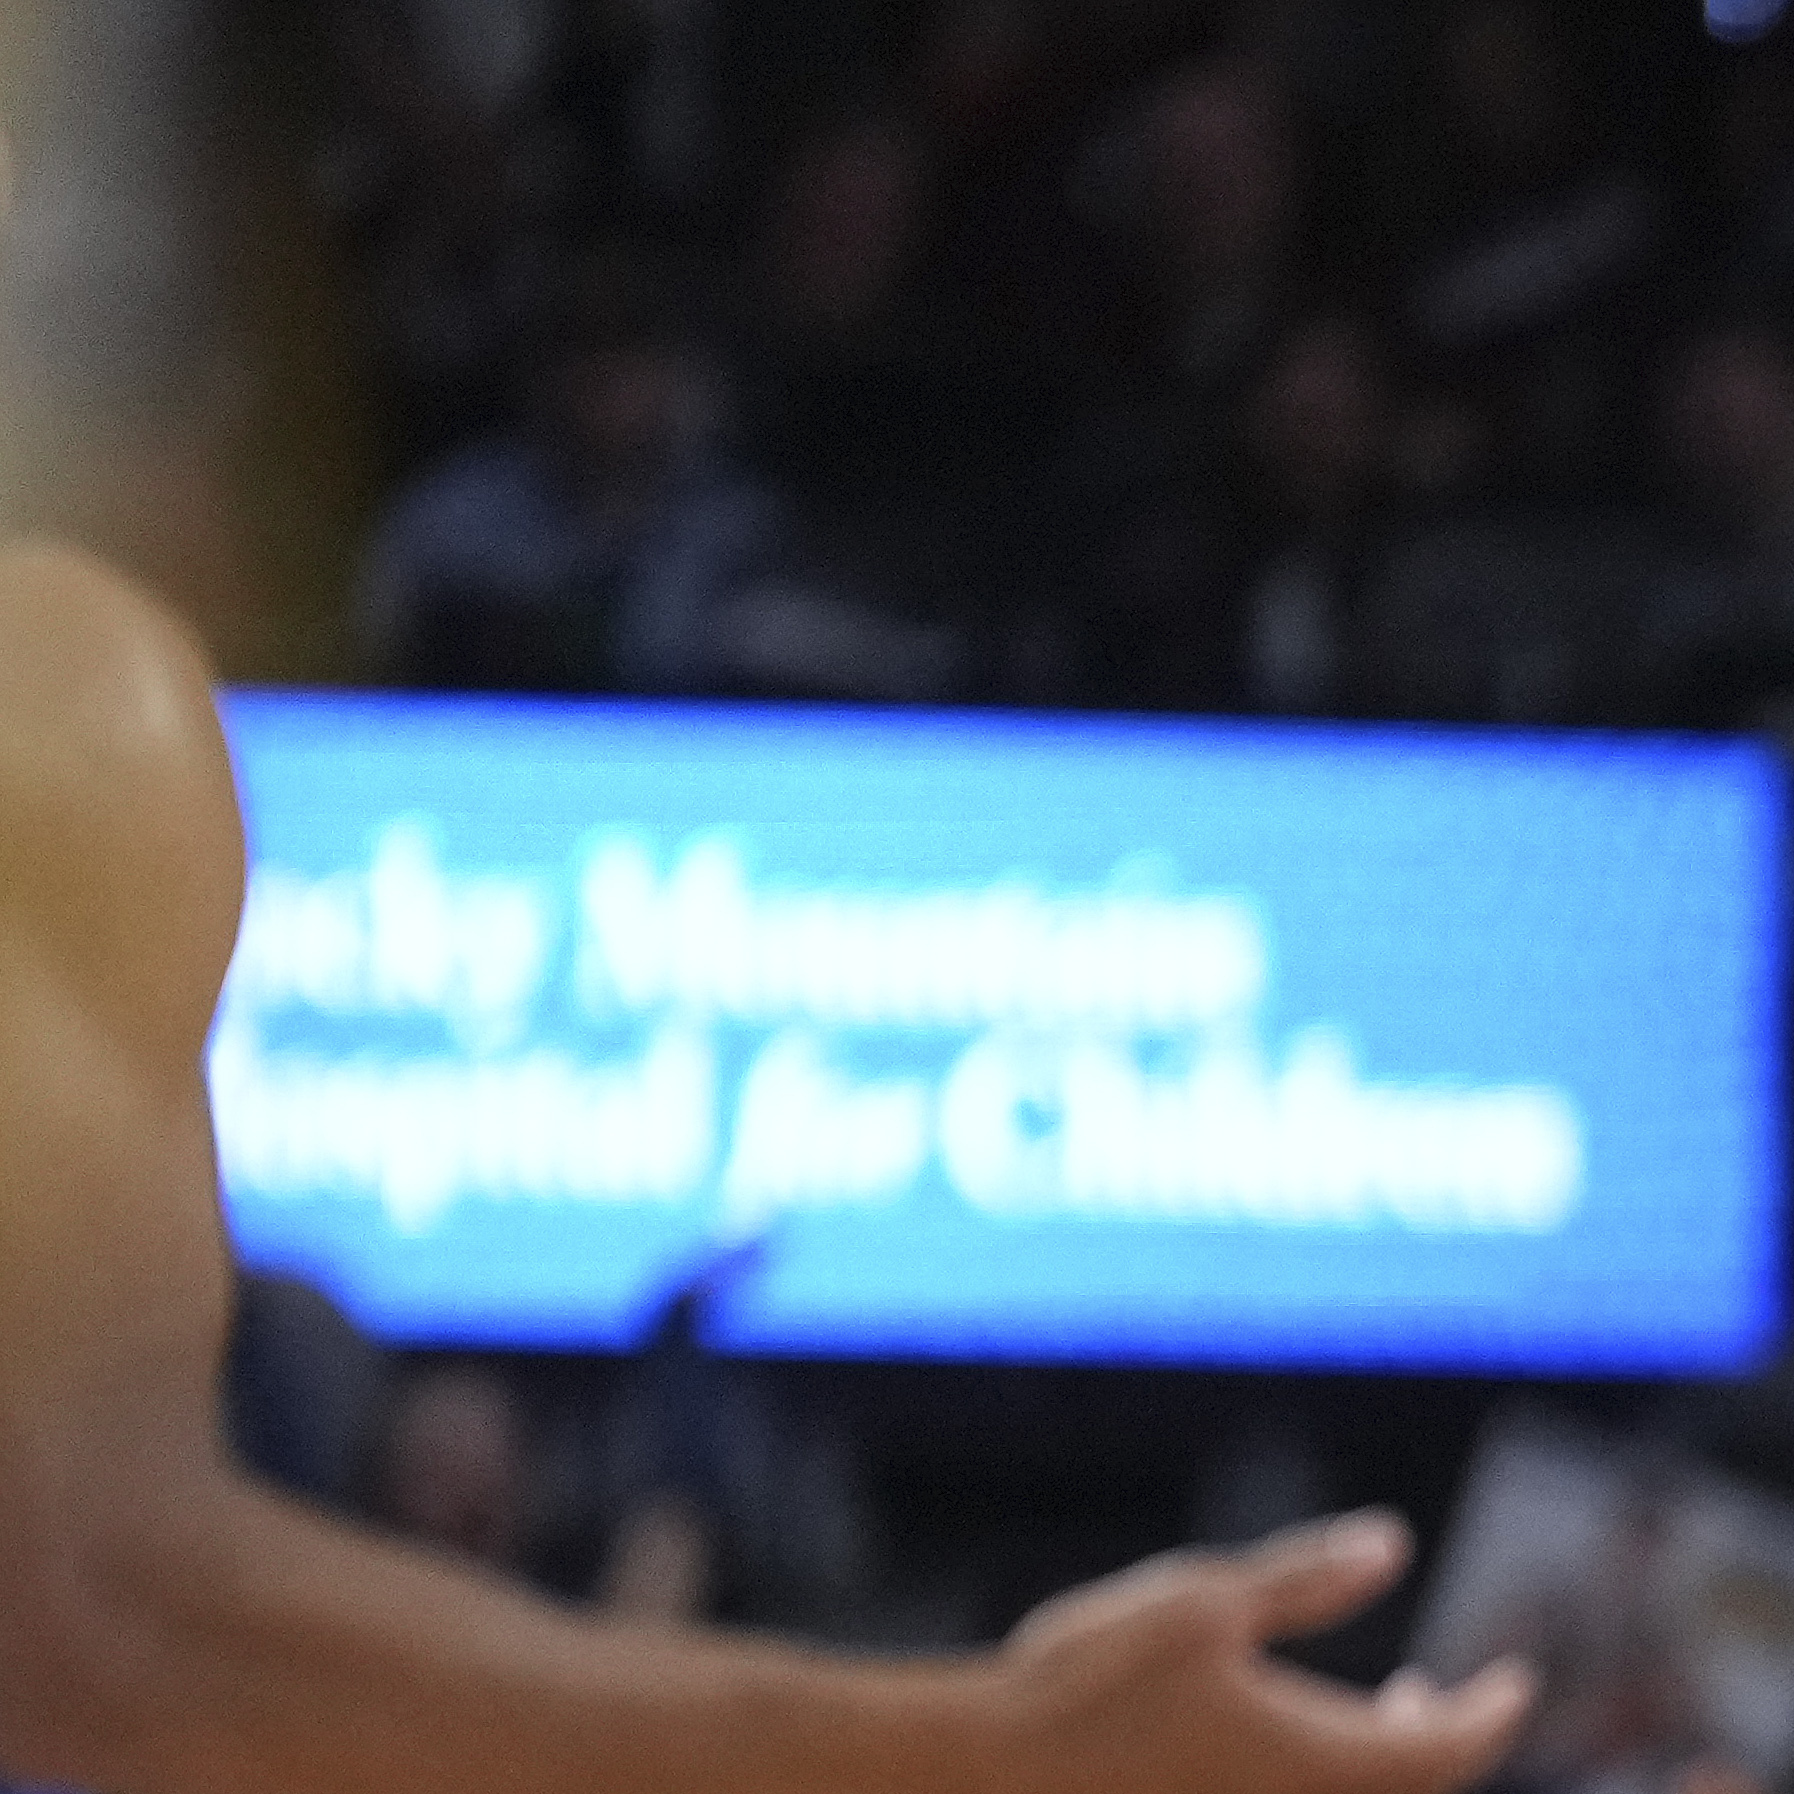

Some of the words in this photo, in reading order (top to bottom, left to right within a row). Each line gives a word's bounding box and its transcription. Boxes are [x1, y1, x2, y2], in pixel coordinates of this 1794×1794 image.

[582, 832, 1266, 1025] Mountain
[722, 1027, 926, 1240] for
[938, 1023, 1588, 1235] Children
